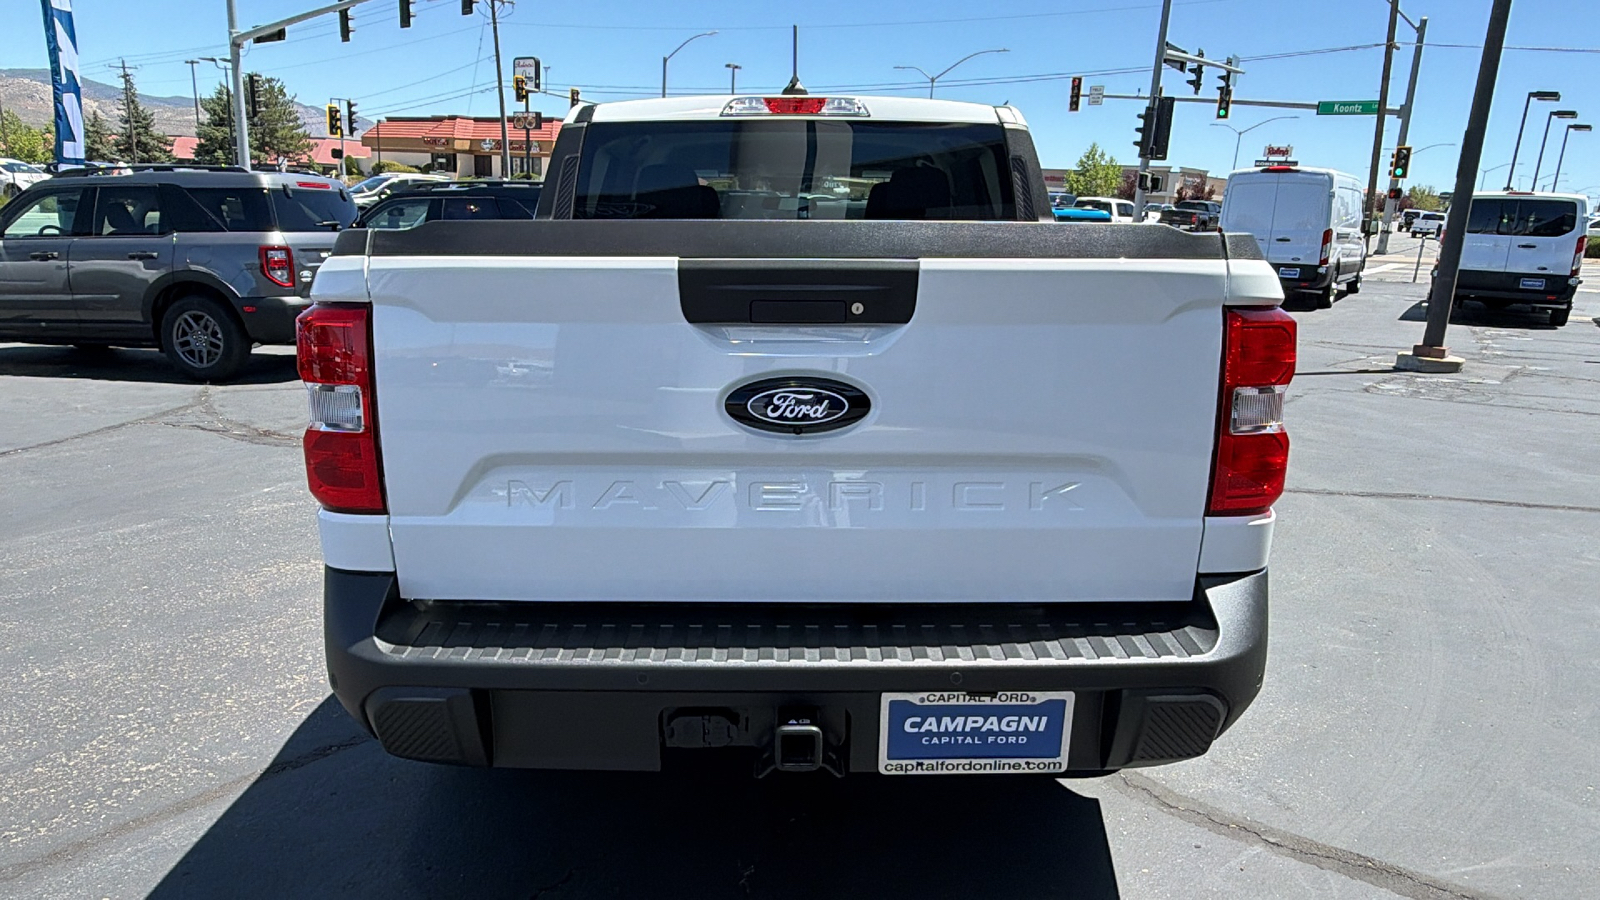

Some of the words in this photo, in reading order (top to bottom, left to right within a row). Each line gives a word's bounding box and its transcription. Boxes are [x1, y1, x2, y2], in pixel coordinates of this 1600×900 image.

[1333, 103, 1363, 113] Koontz
[766, 392, 830, 419] Ford
[507, 479, 1085, 511] MAVERICK
[926, 693, 985, 703] CAPITAL
[903, 716, 1048, 733] CAMPAGNI
[921, 736, 983, 745] CAPITAL
[987, 736, 1028, 744] FORD
[884, 760, 1063, 774] capitalfordonline.com
